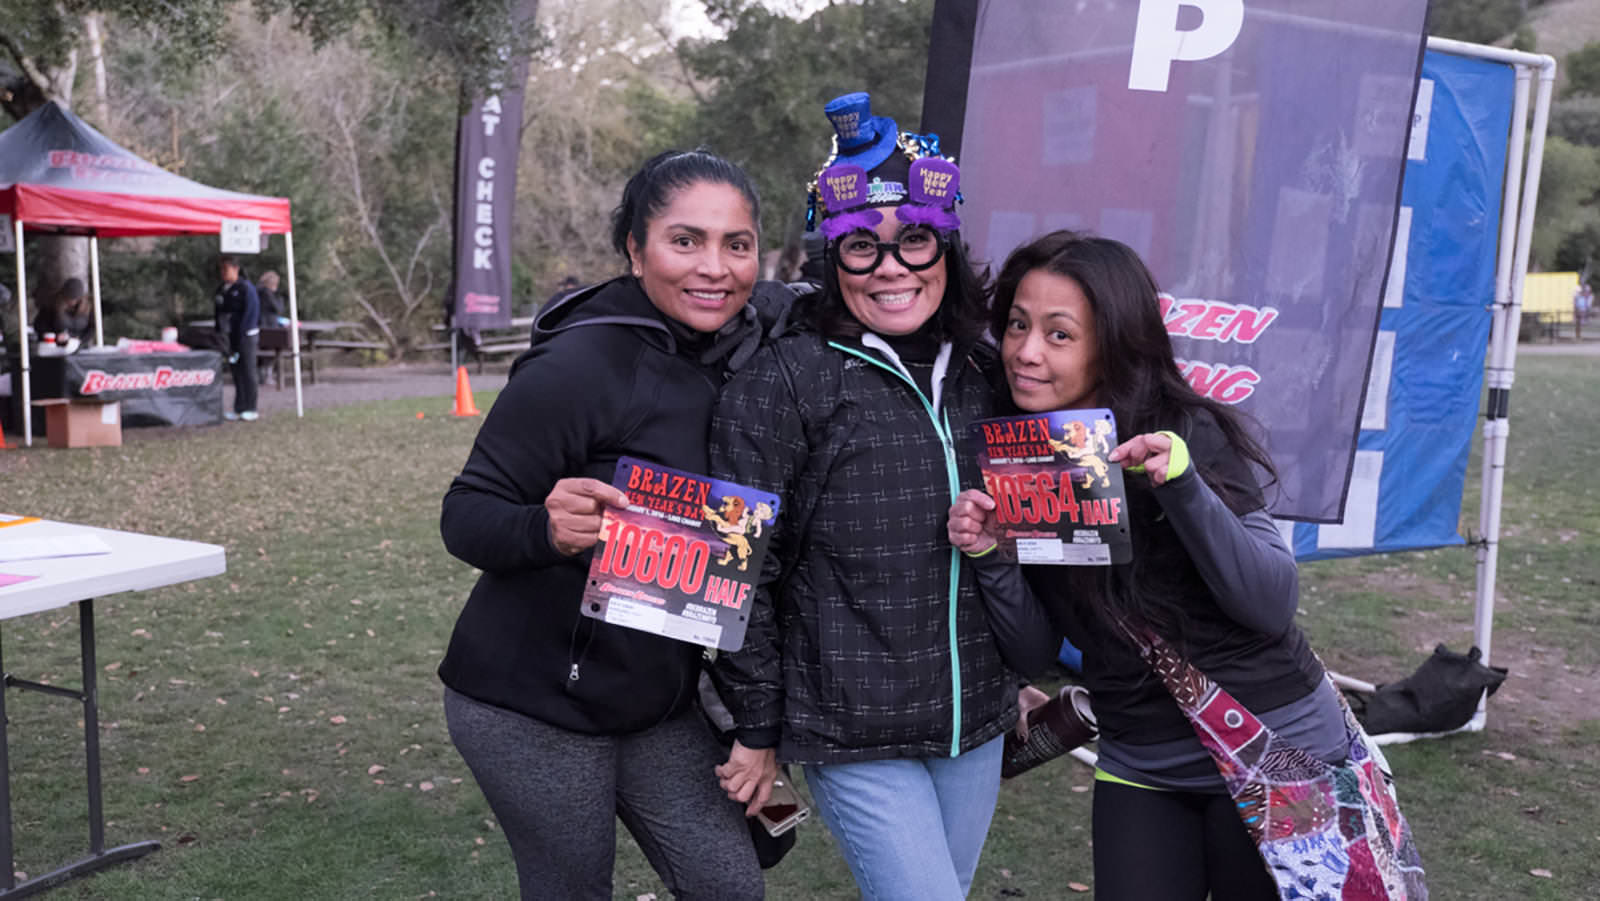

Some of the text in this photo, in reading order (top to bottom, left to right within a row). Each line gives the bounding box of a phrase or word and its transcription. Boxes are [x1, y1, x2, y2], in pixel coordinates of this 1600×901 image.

[1128, 0, 1244, 92] P
[920, 167, 952, 182] Happy
[924, 177, 948, 189] New
[924, 186, 948, 198] Year
[473, 157, 495, 270] CHECK
[983, 417, 1051, 445] BRAZEN
[628, 465, 711, 505] BRAZEN
[987, 472, 1120, 525] 10564 HALF
[600, 522, 710, 594] 10600
[704, 575, 751, 609] HALF
